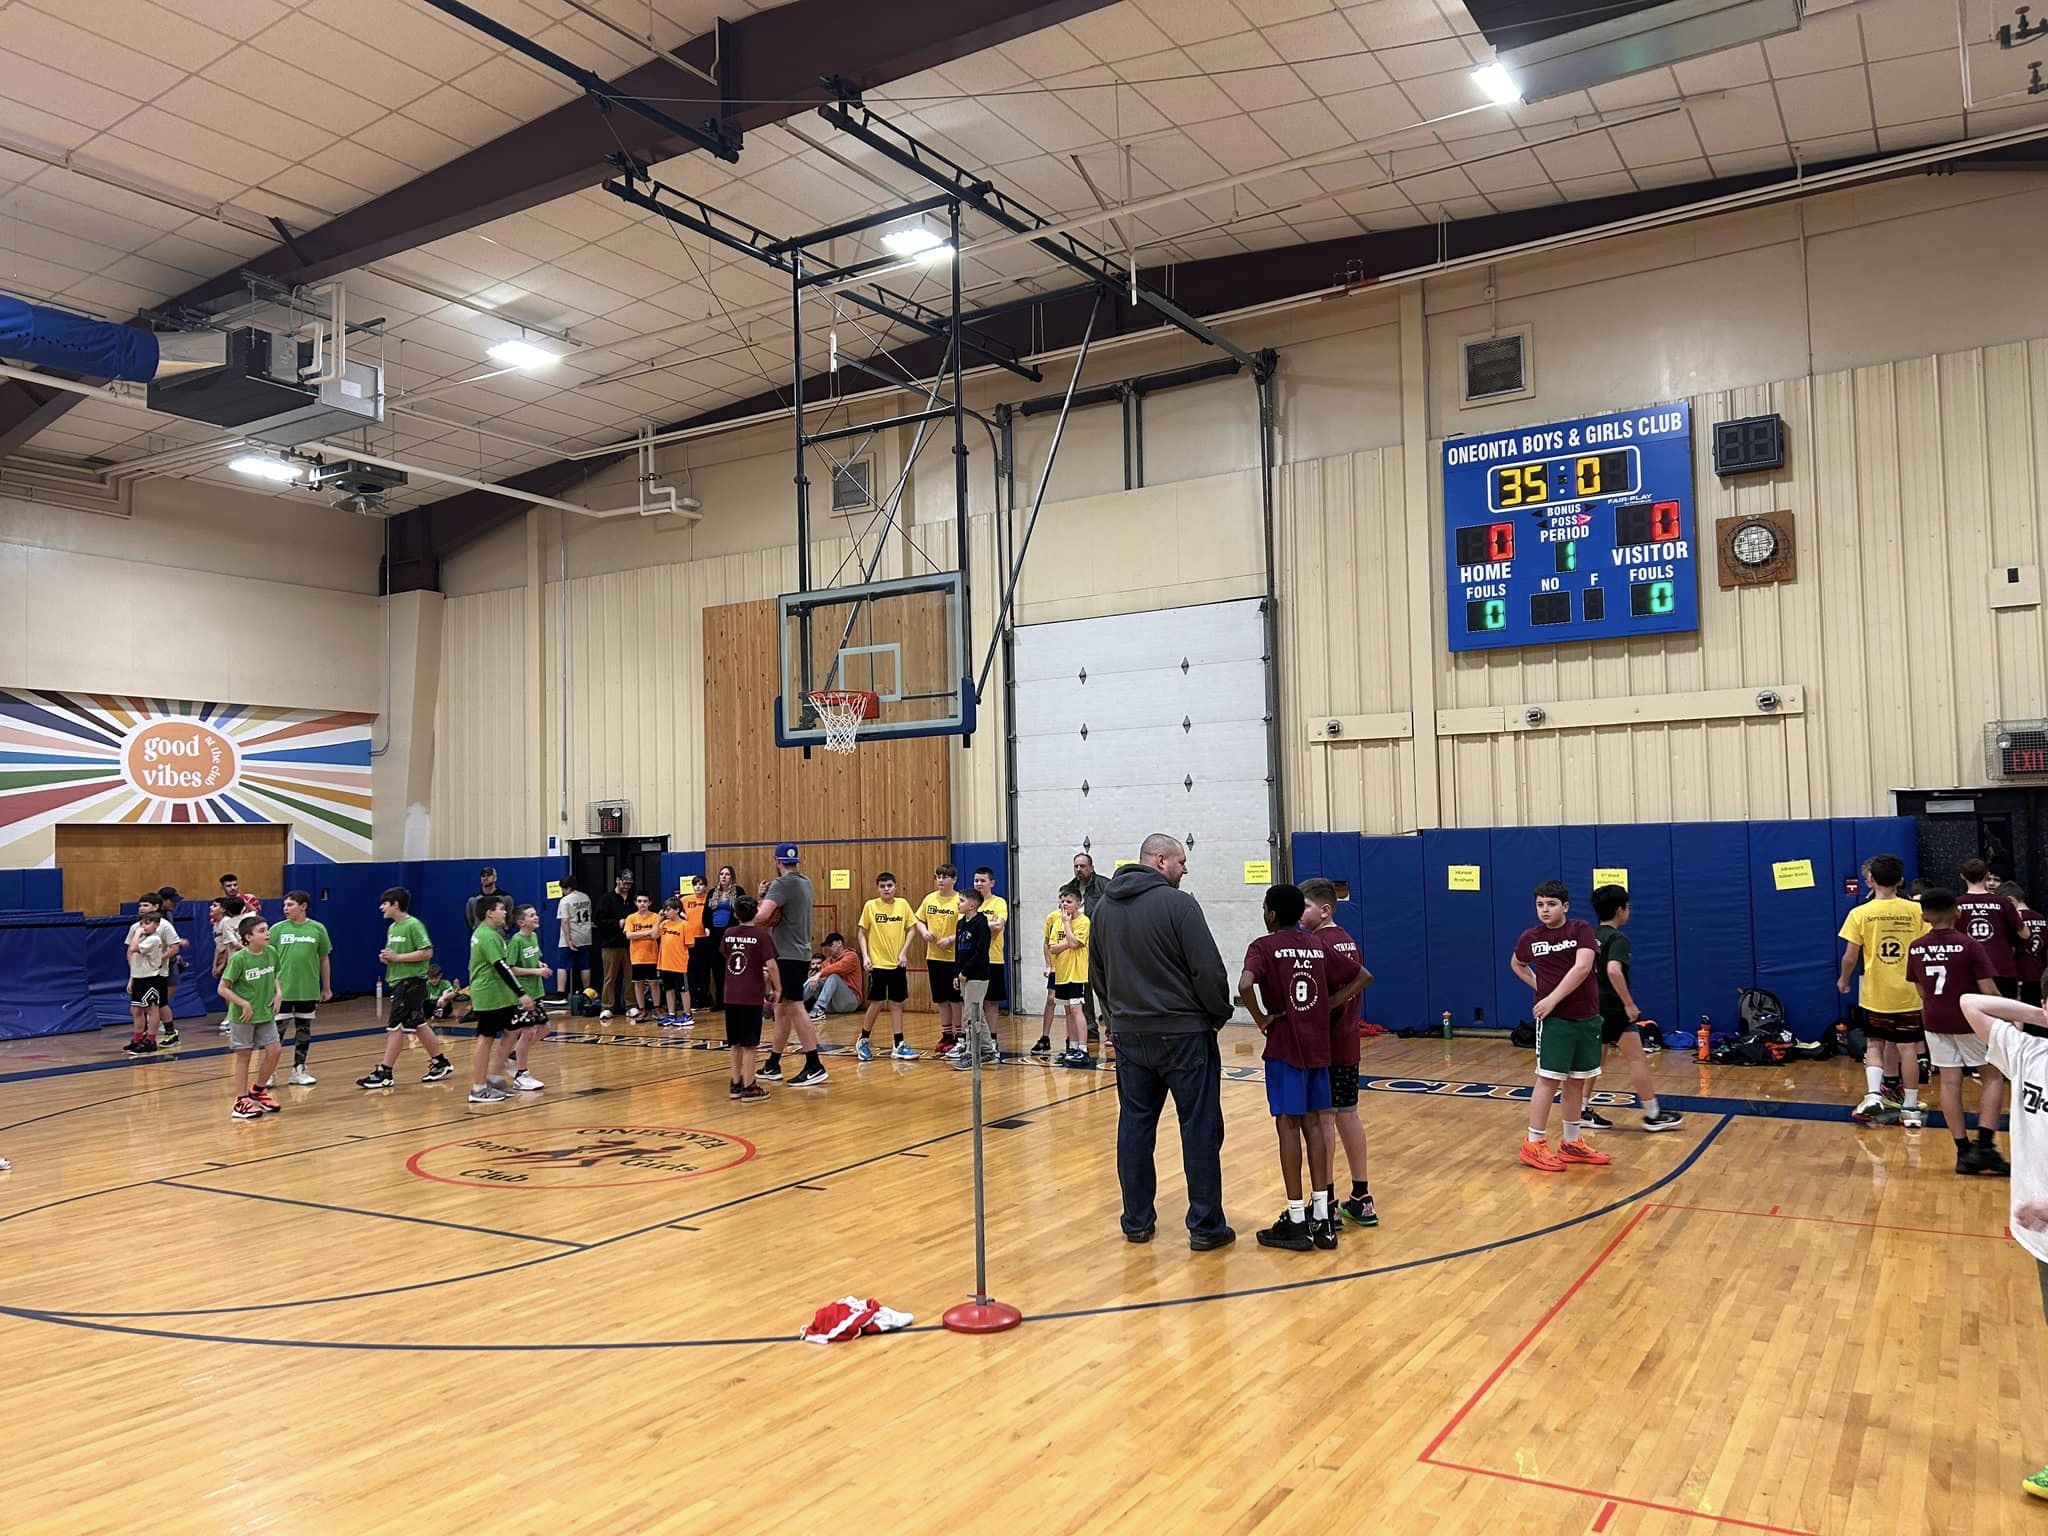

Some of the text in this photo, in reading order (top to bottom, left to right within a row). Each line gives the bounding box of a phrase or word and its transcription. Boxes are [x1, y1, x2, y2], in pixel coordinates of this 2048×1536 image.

[1448, 412, 1682, 465] ONEONTA BOYS & GIRLS CLUB
[1547, 503, 1581, 516] BONUS
[1551, 515, 1578, 527] POSS
[1652, 501, 1679, 540] 0
[1490, 523, 1513, 560] 0
[1540, 525, 1589, 543] PERIOD
[1567, 541, 1575, 569] 1
[1611, 541, 1688, 566] VISITOR
[1460, 561, 1512, 583] HOME
[1590, 572, 1598, 586] F
[1630, 564, 1674, 581] FOULS
[1466, 583, 1506, 599] FOULS
[1541, 577, 1559, 592] NO
[1651, 581, 1673, 613] 0
[1485, 600, 1505, 629] 0
[144, 734, 200, 762] good
[211, 746, 223, 765] the
[142, 763, 202, 788] vibes
[204, 765, 221, 787] club
[1971, 923, 1990, 937] 10
[1274, 948, 1296, 959] 6TH
[1881, 942, 1901, 957] 12
[1910, 945, 1963, 955] 6th WARD
[1921, 953, 1949, 961] A.C.
[735, 956, 741, 970] 1
[1293, 959, 1313, 968] A.C.
[1925, 965, 1947, 995] 7
[457, 1140, 530, 1154] Boys
[620, 1157, 700, 1173] Girls
[459, 1168, 530, 1183] Club
